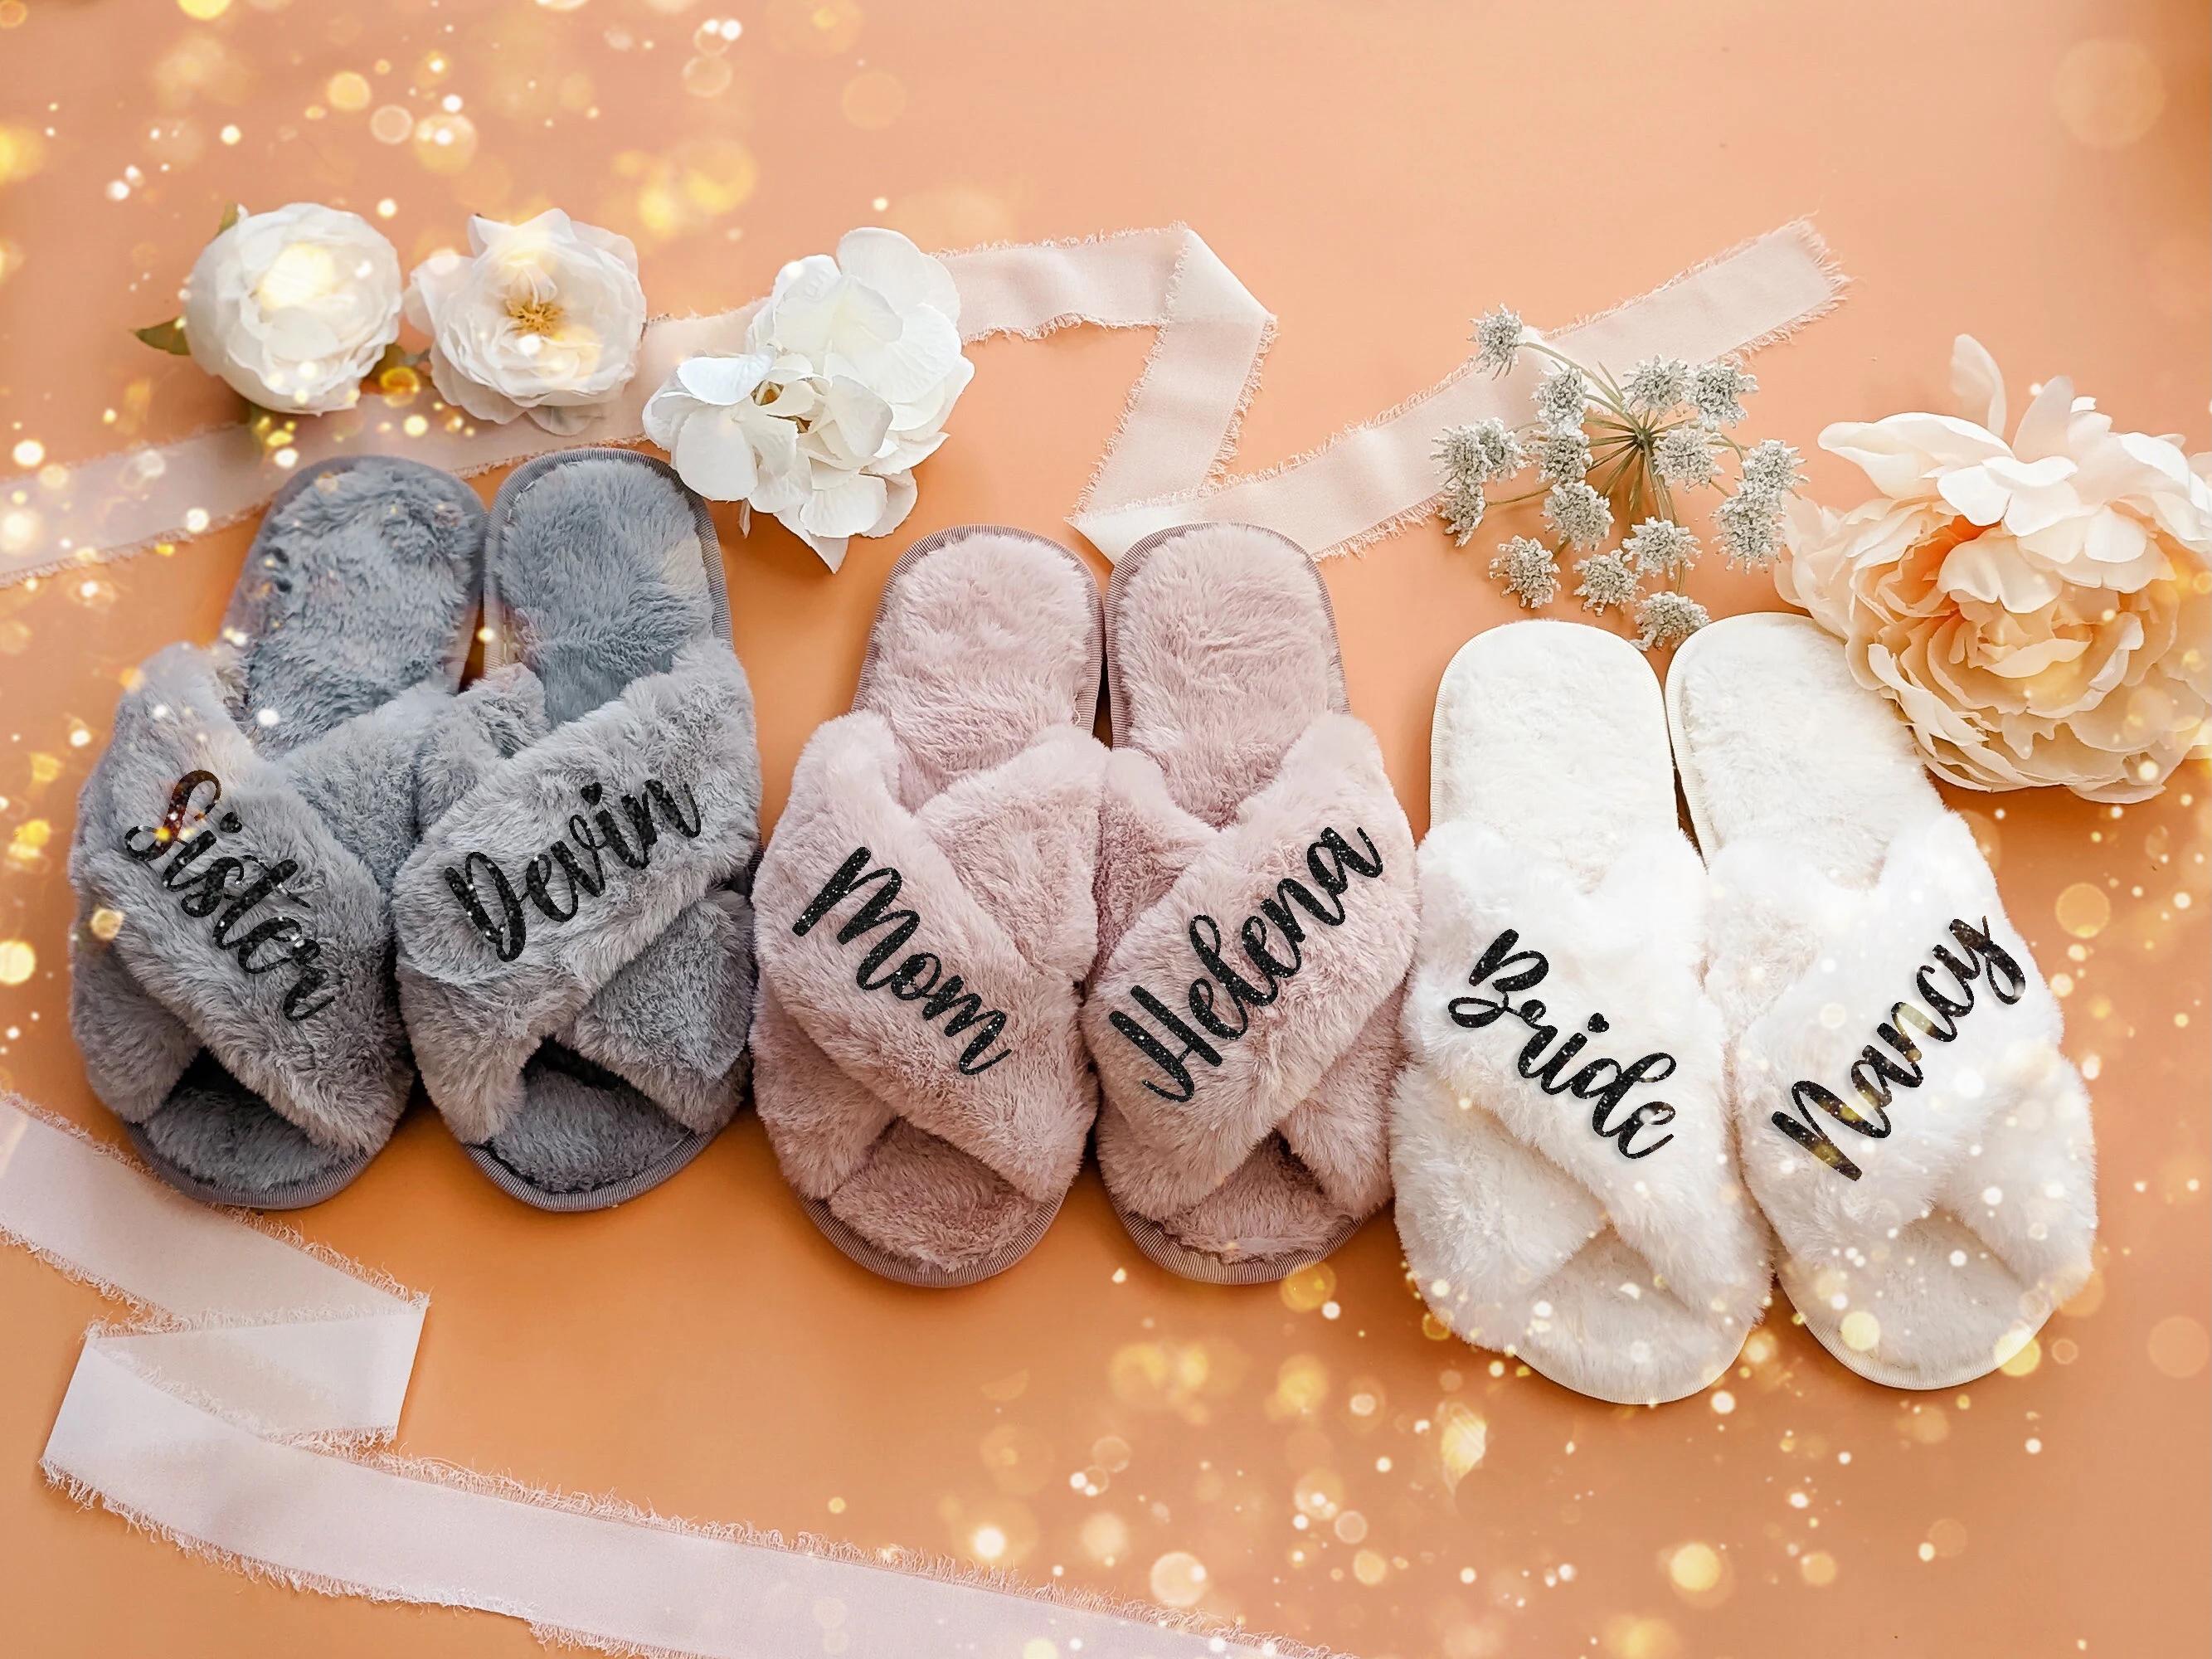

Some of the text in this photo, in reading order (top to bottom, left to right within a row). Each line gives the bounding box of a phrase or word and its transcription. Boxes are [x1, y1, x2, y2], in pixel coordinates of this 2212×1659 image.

[124, 770, 335, 1021] Sister
[445, 779, 701, 961] Devin
[793, 846, 1012, 1076] Mom
[1110, 826, 1383, 1102] Helena
[1448, 929, 1676, 1159] Bride
[1772, 917, 2025, 1181] Nancy
